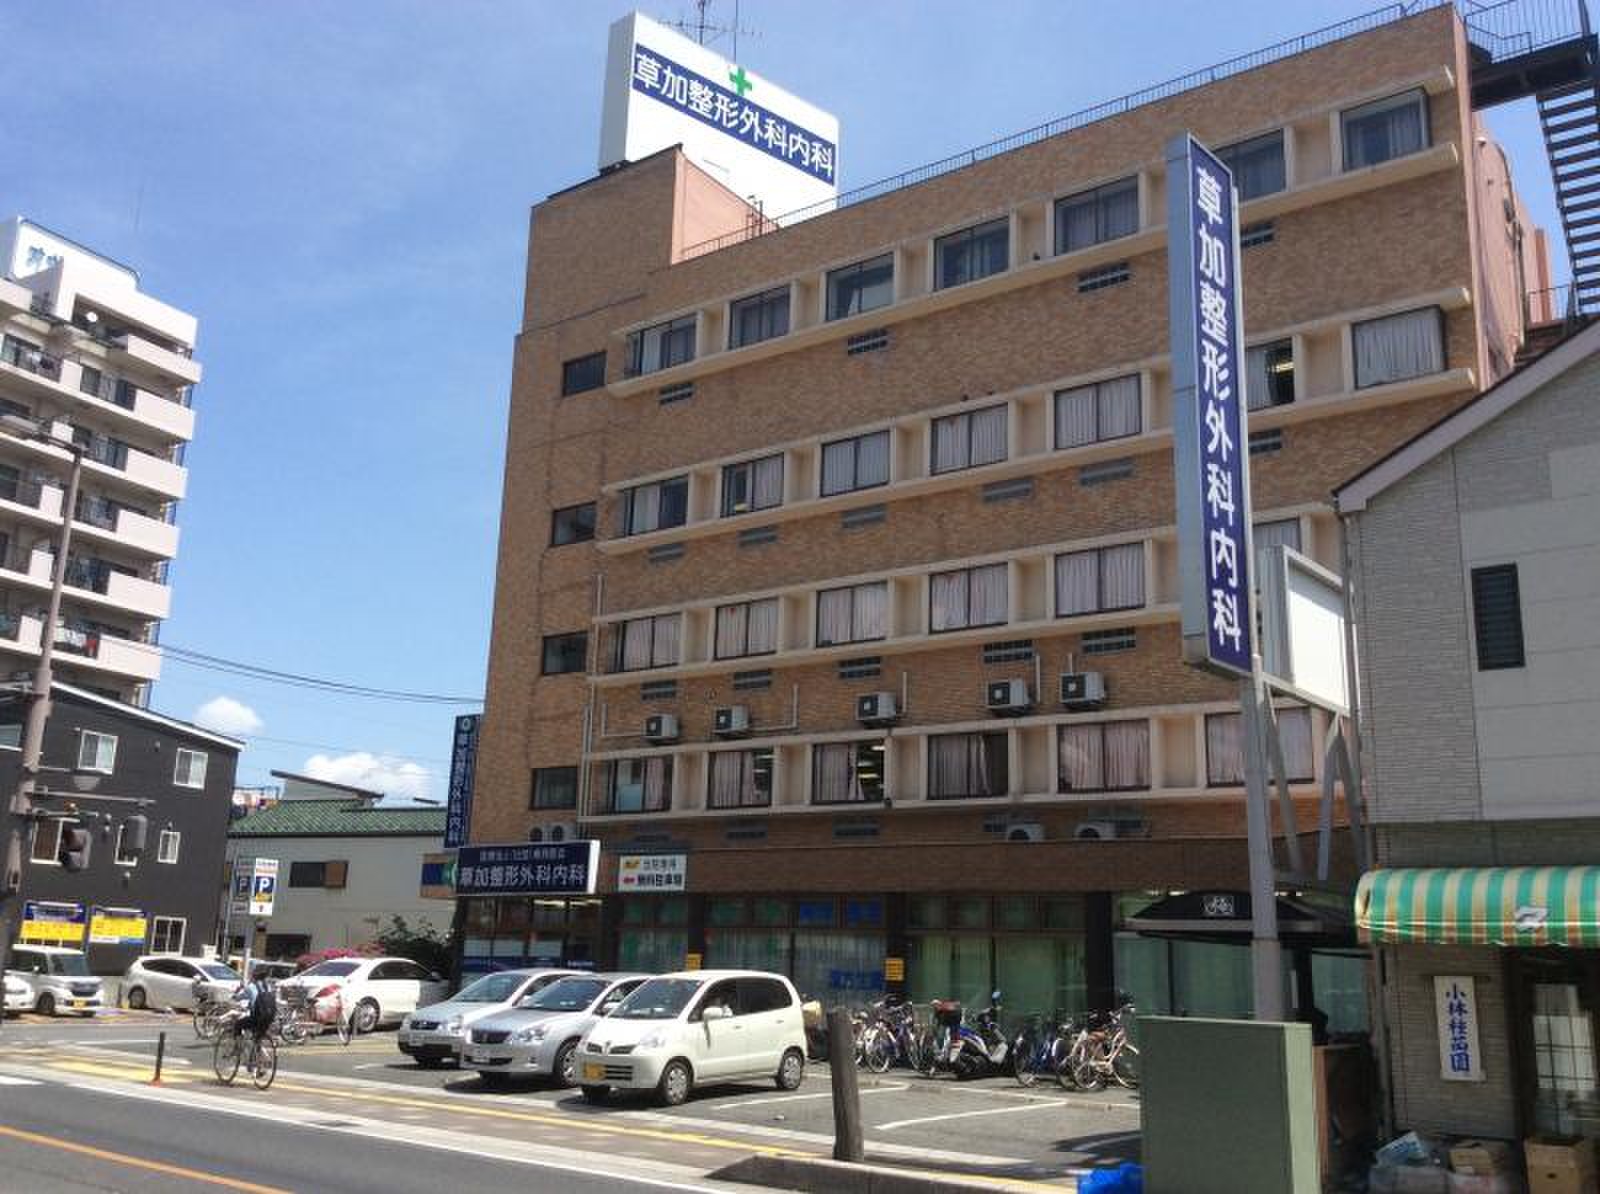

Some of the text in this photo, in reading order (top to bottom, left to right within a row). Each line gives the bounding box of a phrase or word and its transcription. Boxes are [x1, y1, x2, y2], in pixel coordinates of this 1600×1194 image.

[635, 52, 833, 178] 草加整形外科内科
[1196, 166, 1242, 653] 草加整形外科内科
[259, 877, 271, 893] P
[460, 862, 586, 887] 草加整形外科内科
